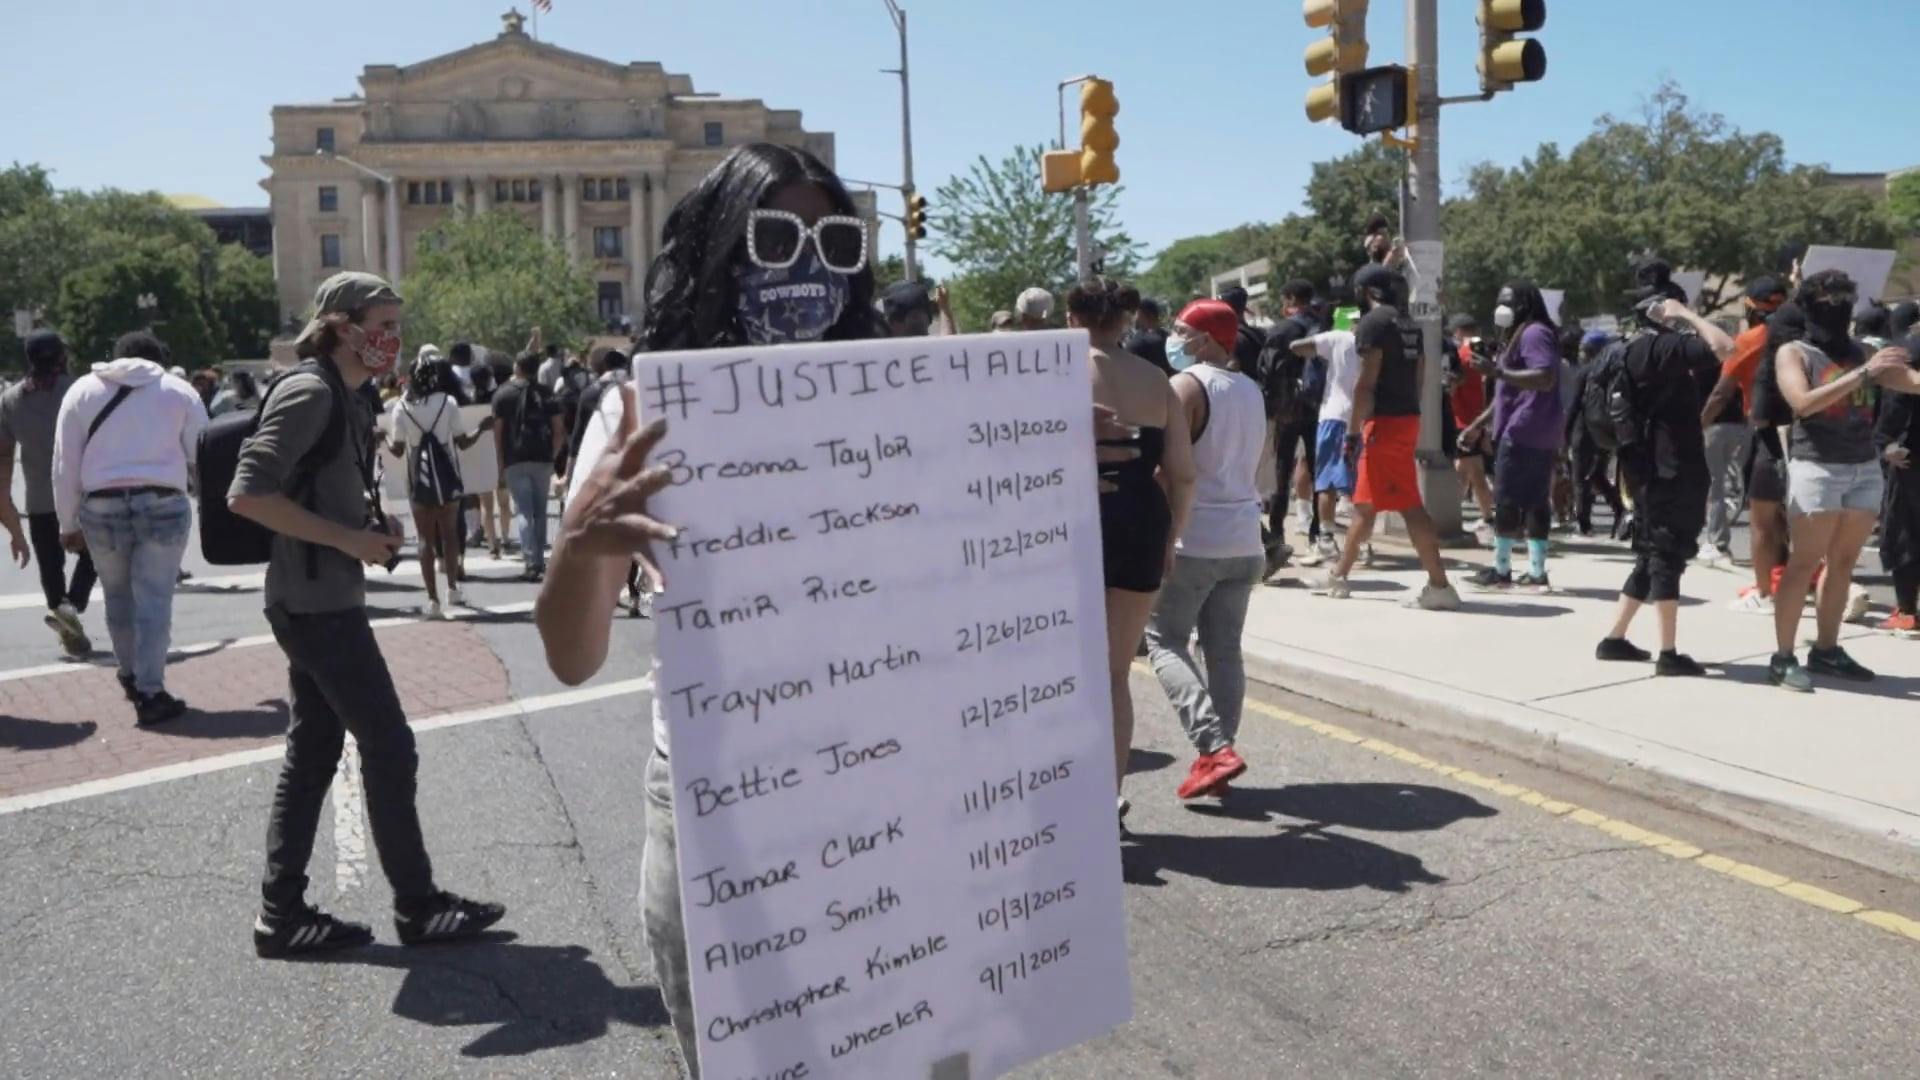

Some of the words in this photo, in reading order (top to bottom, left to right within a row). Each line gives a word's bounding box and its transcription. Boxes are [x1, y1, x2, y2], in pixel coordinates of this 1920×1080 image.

[760, 283, 826, 302] COWBOYS
[950, 350, 969, 382] 4
[987, 342, 1071, 377] ALL!!
[968, 419, 1067, 448] 3/13/2020
[967, 468, 1064, 505] 4/19/2015
[802, 576, 877, 603] Rice
[963, 523, 1067, 568] 11/22/2014
[671, 679, 813, 723] Trayvon
[828, 644, 920, 687] Martin
[957, 610, 1073, 652] 2/26/2012
[686, 766, 802, 817] Bettie
[816, 738, 902, 775] Jones
[961, 677, 1075, 728] 12/25/2015
[964, 761, 1073, 814] 11/15/2015
[705, 927, 807, 972] Alonzo
[826, 886, 900, 932] Smith
[970, 824, 1056, 870] 11/1/2015
[866, 936, 947, 980] Kimble
[978, 881, 1075, 931] 10/3/2015
[980, 939, 1070, 994] 9/7/2015
